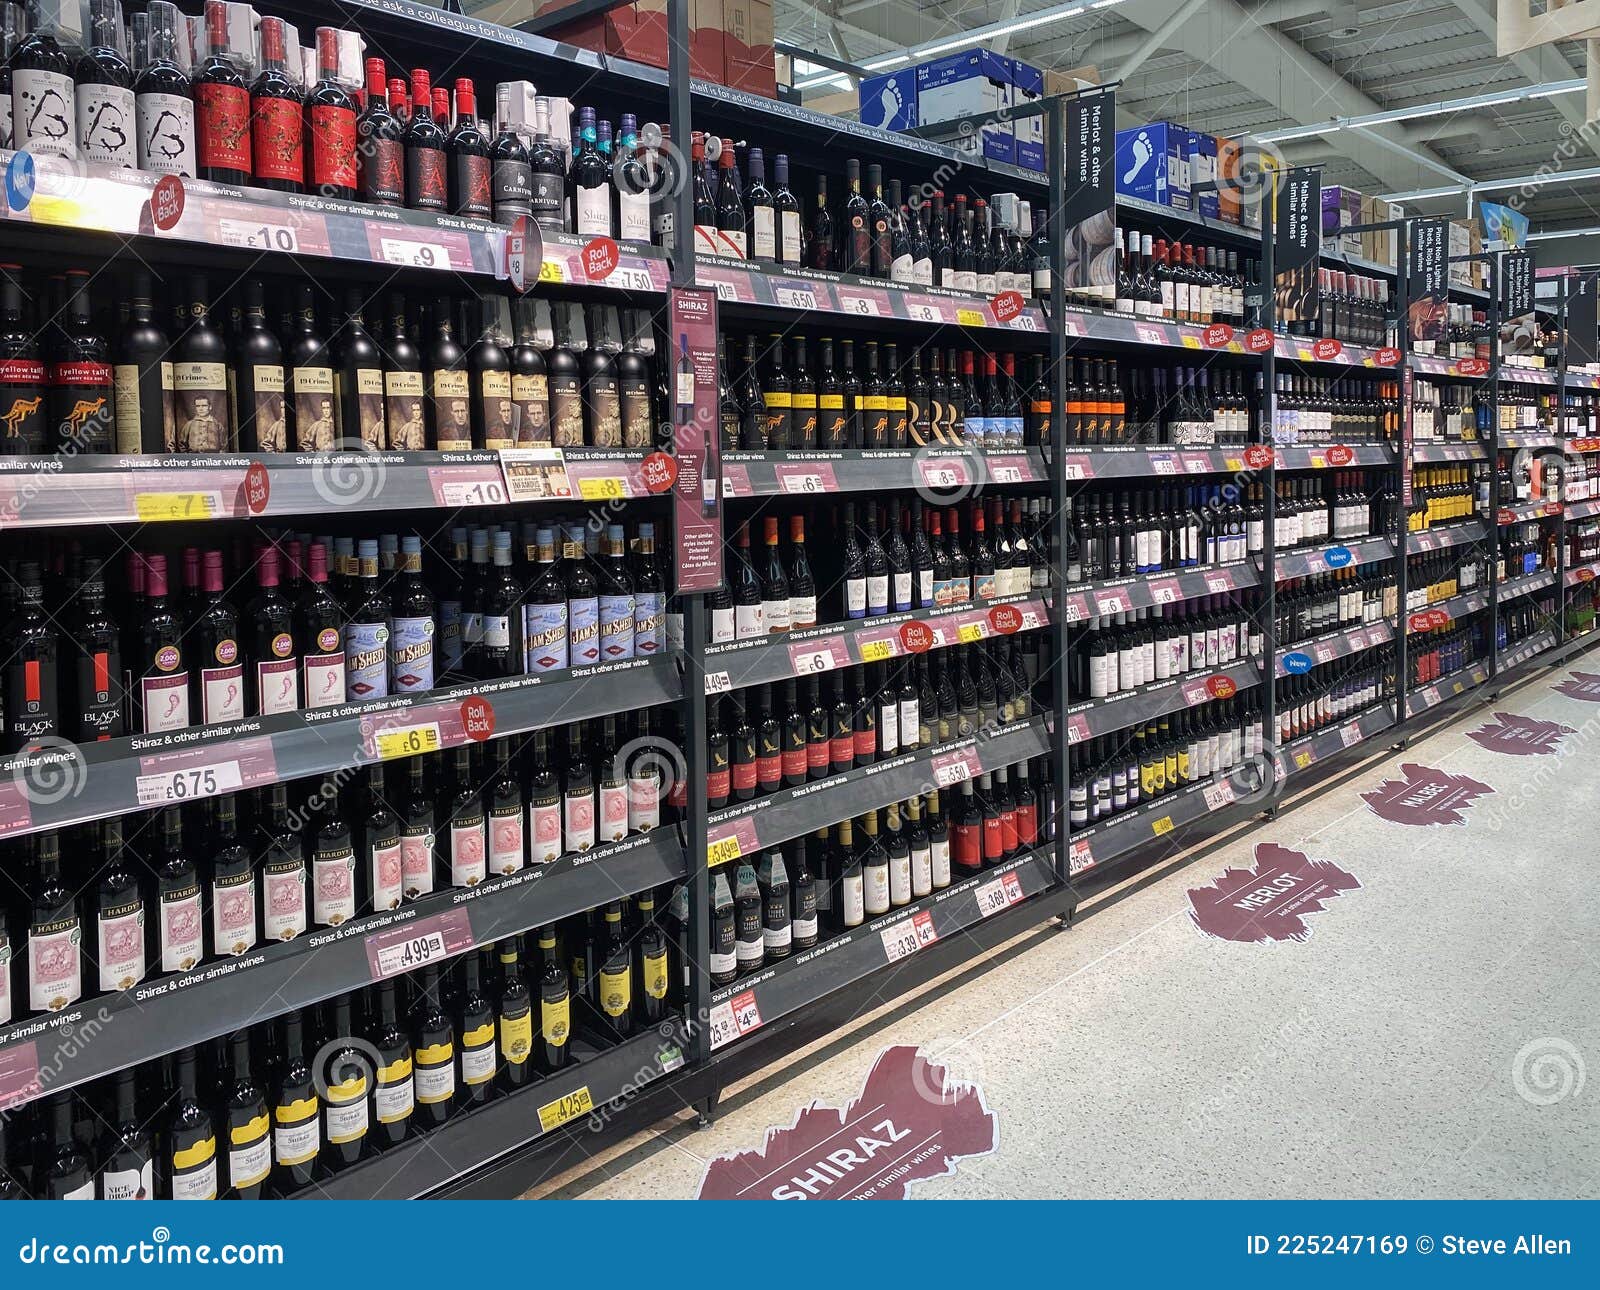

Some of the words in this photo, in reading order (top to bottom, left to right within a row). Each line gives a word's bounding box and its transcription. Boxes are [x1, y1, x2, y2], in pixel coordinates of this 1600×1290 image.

[383, 2, 404, 14] ask
[418, 10, 476, 31] colleague
[479, 24, 495, 37] for
[498, 29, 527, 46] help.
[732, 92, 771, 110] additional
[1080, 108, 1089, 145] similar
[1092, 106, 1101, 143] Merlot
[1092, 146, 1101, 154] &
[1080, 149, 1088, 182] wines
[1092, 157, 1101, 188] other
[158, 184, 175, 203] Roll
[376, 189, 400, 198] APOTHIC
[1290, 182, 1298, 211] similar
[1301, 181, 1309, 213] Malbec
[157, 202, 179, 221] Back
[289, 197, 316, 209] Shiraz
[317, 201, 324, 209] &
[325, 202, 347, 213] other
[349, 205, 375, 216] similar
[376, 208, 399, 219] wines
[1290, 214, 1298, 239] wines
[1300, 224, 1308, 248] other
[248, 226, 294, 251] £10
[413, 247, 435, 266] £9
[589, 245, 608, 261] Roll
[589, 257, 612, 274] Back
[678, 301, 707, 311] SHIRAZ
[856, 300, 869, 314] £8
[998, 296, 1013, 309] Roll
[998, 304, 1018, 317] Back
[1209, 325, 1225, 337] Roll
[1209, 335, 1229, 344] Back
[1252, 333, 1266, 342] Roll
[1252, 340, 1271, 349] Back
[120, 458, 152, 468] Shiraz
[154, 459, 163, 467] &
[165, 459, 190, 468] other
[191, 458, 221, 467] similar
[223, 457, 250, 467] wines
[648, 458, 666, 474] Roll
[649, 472, 671, 486] Back
[803, 477, 815, 492] £6
[466, 484, 500, 505] £10
[170, 493, 195, 517] £7
[1330, 553, 1347, 561] New
[1108, 600, 1117, 612] £6
[613, 615, 634, 634] SHED
[907, 628, 924, 639] Roll
[972, 625, 981, 638] £6
[529, 634, 544, 650] JAM
[545, 626, 566, 645] SHED
[906, 637, 928, 647] Back
[358, 648, 384, 670] SHED
[406, 641, 431, 663] SHED
[1290, 660, 1307, 668] New
[84, 709, 120, 722] BLACK
[468, 706, 486, 719] Roll
[14, 720, 53, 732] BLACK
[468, 718, 489, 732] Back
[131, 737, 163, 750] Shiraz
[164, 735, 172, 745] &
[174, 732, 199, 743] other
[201, 726, 232, 739] similar
[234, 722, 261, 733] wines
[403, 731, 420, 752] £6
[4, 757, 41, 771] similar
[43, 752, 76, 764] wines
[166, 769, 217, 799] £6.75
[1400, 782, 1449, 808] MALBEC
[708, 814, 723, 824] Shiraz
[728, 808, 741, 818] other
[741, 803, 756, 814] similar
[757, 799, 771, 808] wines
[453, 893, 475, 904] Shiraz
[482, 884, 500, 895] other
[501, 878, 522, 889] similar
[524, 870, 543, 881] wines
[1233, 872, 1304, 911] MERLOT
[107, 903, 140, 918] HARDYS
[37, 919, 74, 934] HARDYS
[136, 986, 168, 1001] Shiraz
[169, 981, 177, 991] &
[179, 973, 205, 988] other
[206, 964, 237, 980] similar
[238, 954, 265, 970] wines
[770, 1118, 912, 1200] SHIRAZ
[876, 1161, 912, 1192] similar
[910, 1142, 942, 1167] wines
